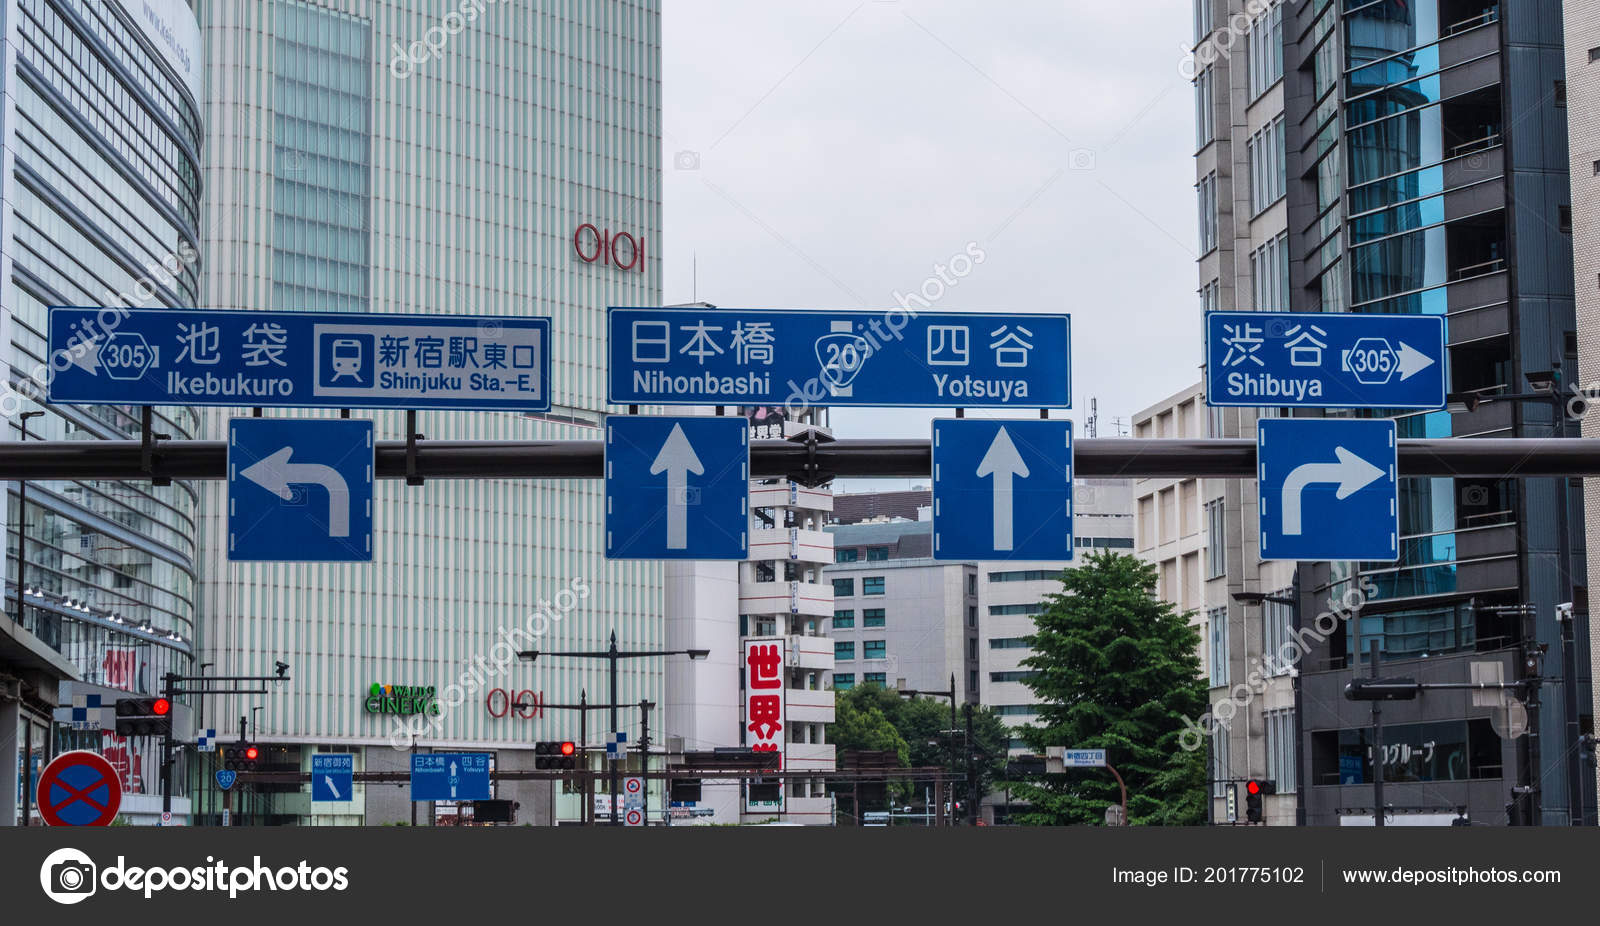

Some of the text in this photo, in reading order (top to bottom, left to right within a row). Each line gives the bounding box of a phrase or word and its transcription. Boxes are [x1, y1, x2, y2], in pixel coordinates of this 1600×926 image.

[107, 344, 145, 368] 305
[175, 321, 288, 367] 池袋
[379, 334, 535, 370] 新宿駅東口
[632, 320, 775, 365] 日本橋
[826, 343, 858, 369] 20
[927, 325, 1033, 367] 四谷
[1222, 322, 1327, 367] 渋谷
[1355, 350, 1391, 373] 305
[167, 371, 294, 396] Ikebukuro
[380, 371, 461, 393] Shinjuku
[633, 370, 770, 395] Nihonbashi
[933, 374, 1028, 402] Yotsuya
[1227, 372, 1322, 401] Shibuya
[365, 696, 441, 715] CINEMA
[748, 644, 782, 770] 世界
